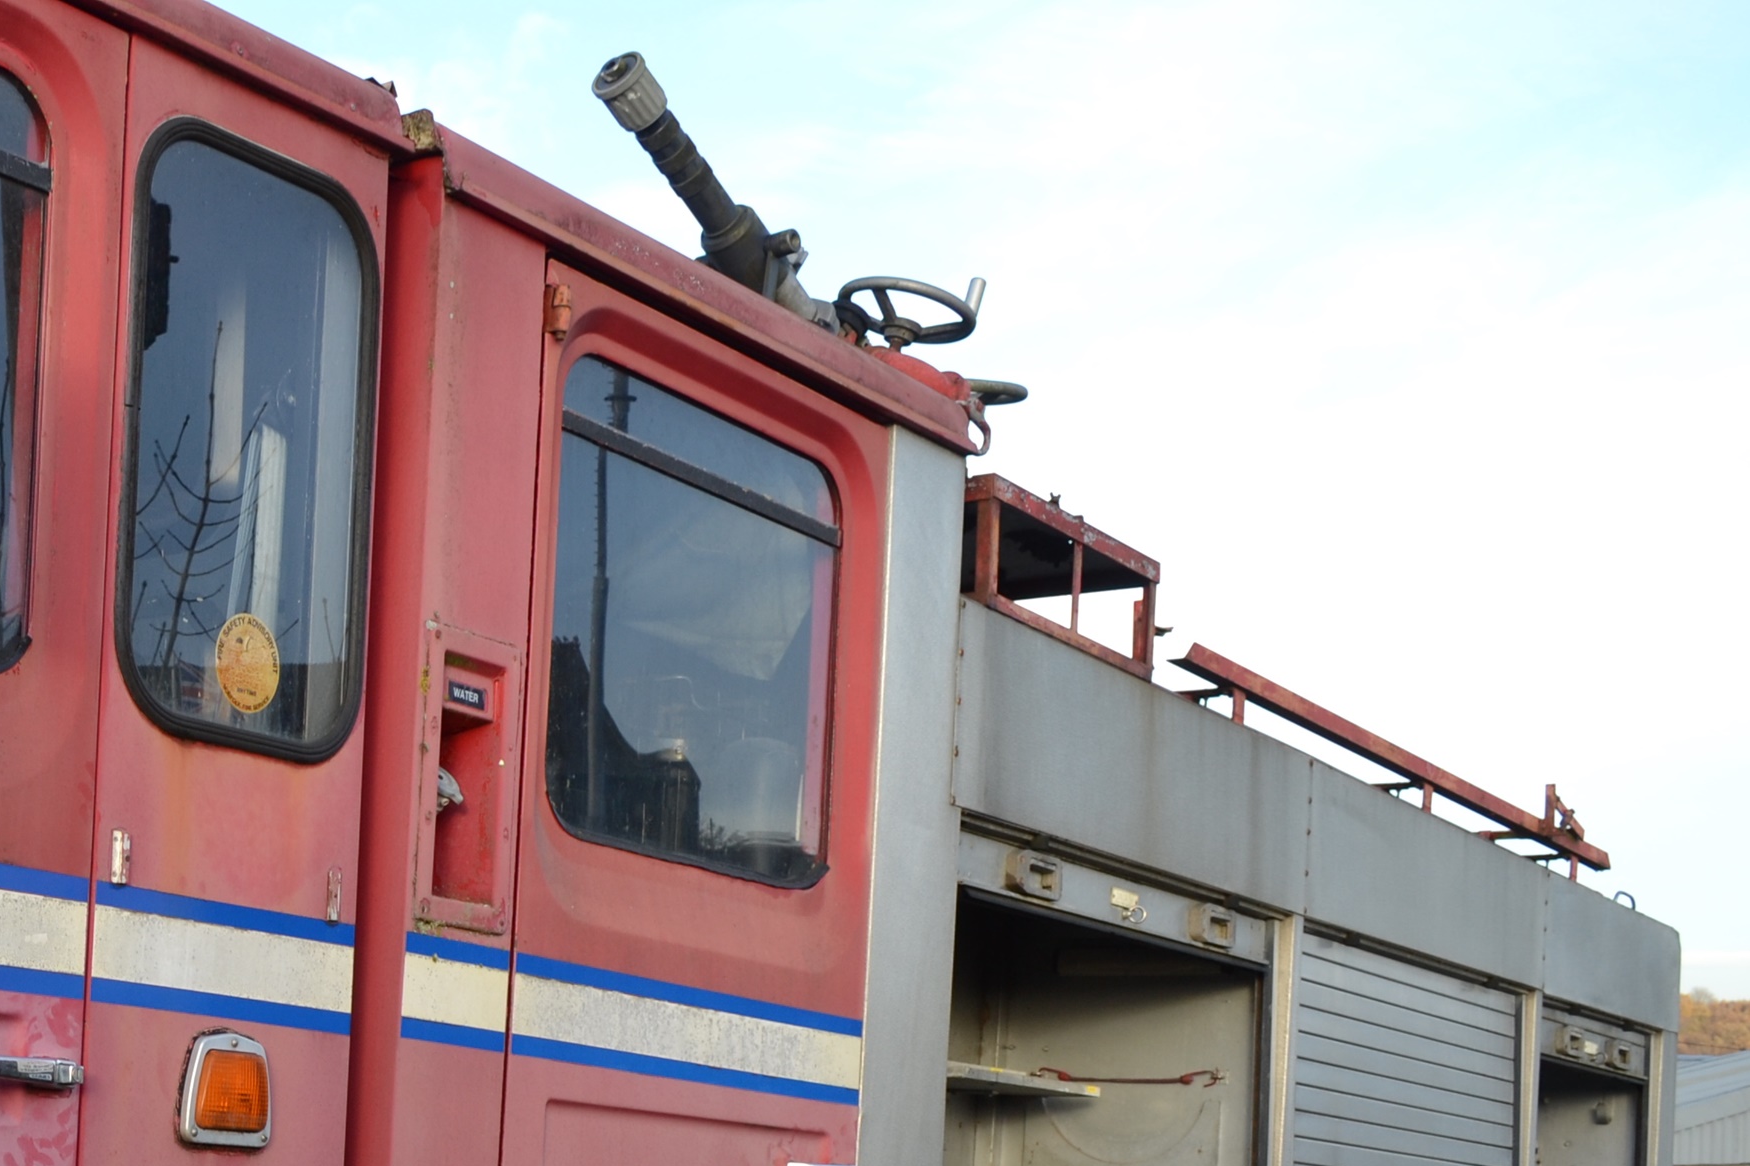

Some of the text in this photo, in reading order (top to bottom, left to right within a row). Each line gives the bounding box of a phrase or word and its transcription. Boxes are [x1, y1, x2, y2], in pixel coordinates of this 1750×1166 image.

[223, 616, 246, 637] SAFETY
[247, 617, 275, 650] ADVISORY
[453, 686, 479, 704] WATER
